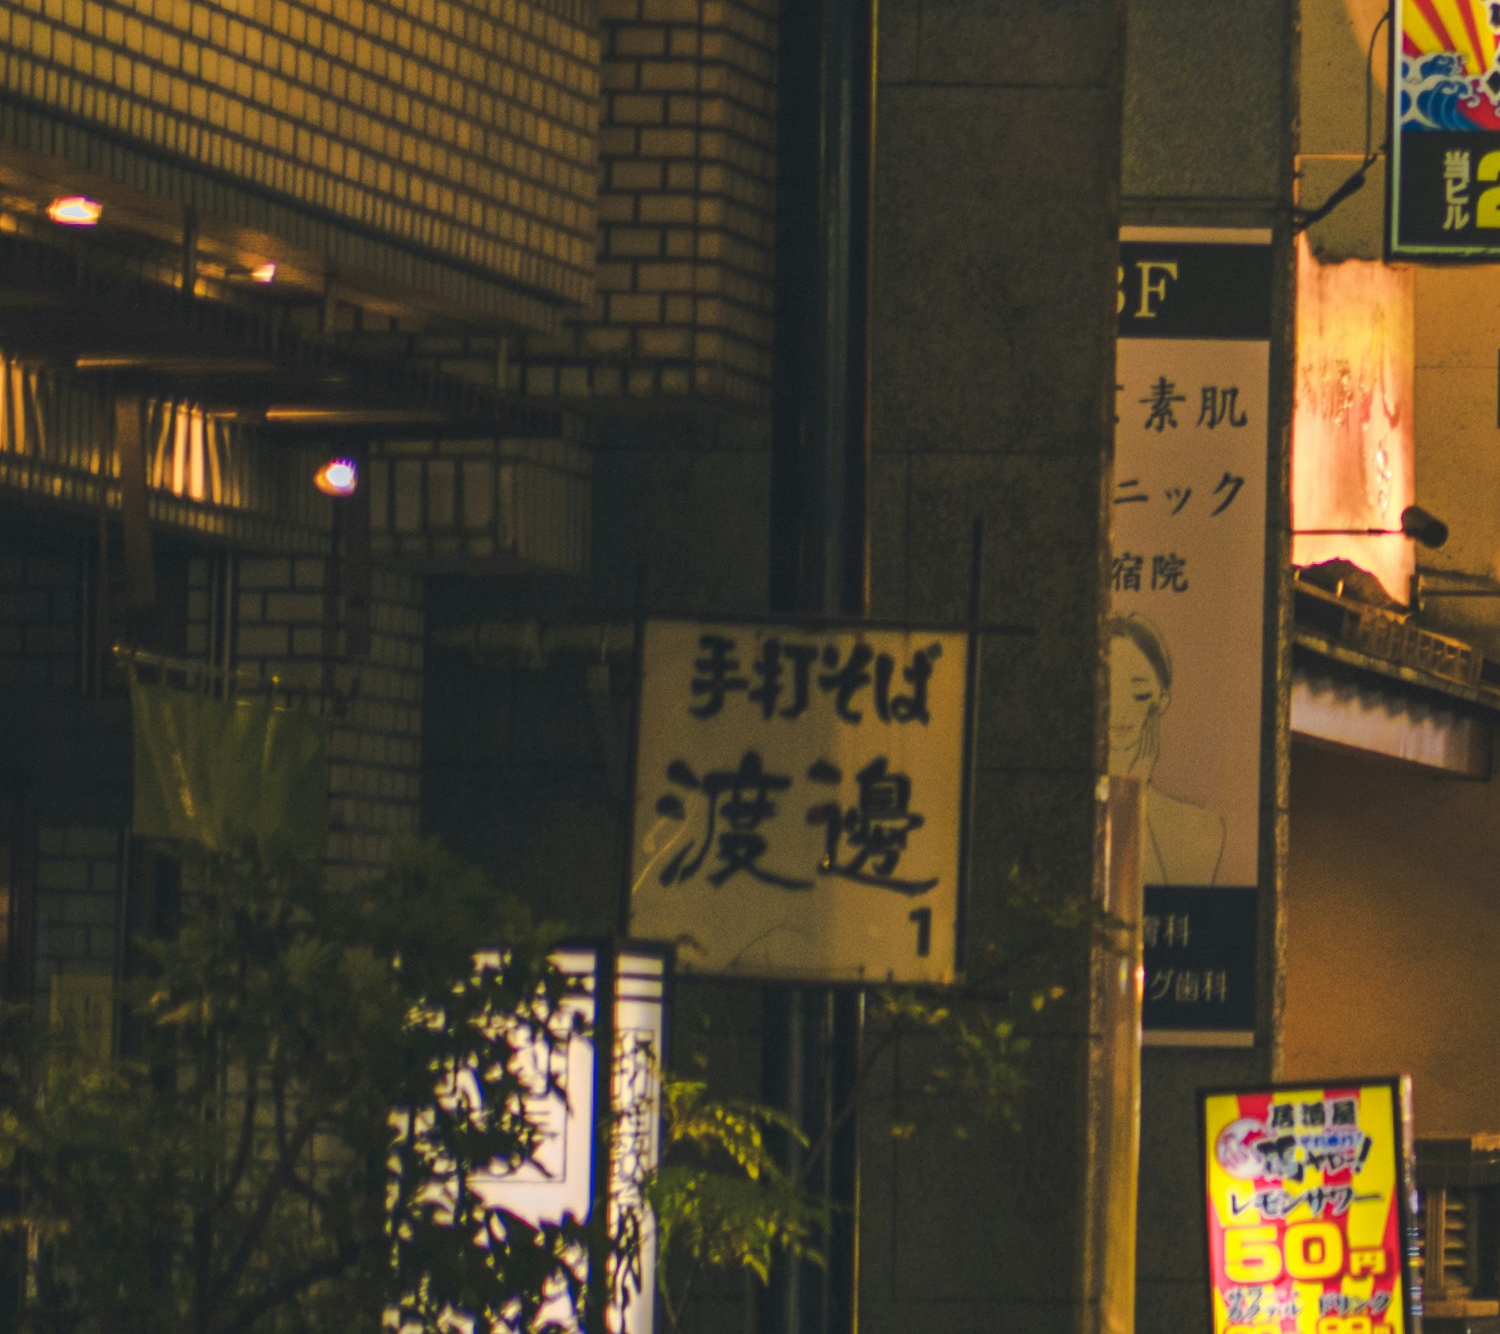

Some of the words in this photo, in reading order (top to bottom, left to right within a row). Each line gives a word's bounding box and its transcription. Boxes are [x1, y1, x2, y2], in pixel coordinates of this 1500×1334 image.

[1443, 151, 1471, 231] 当ビル
[1112, 375, 1249, 430] 素肌
[690, 633, 944, 727] 手打そば
[1230, 1187, 1384, 1216] レモンサワー
[1223, 1220, 1387, 1285] 50円
